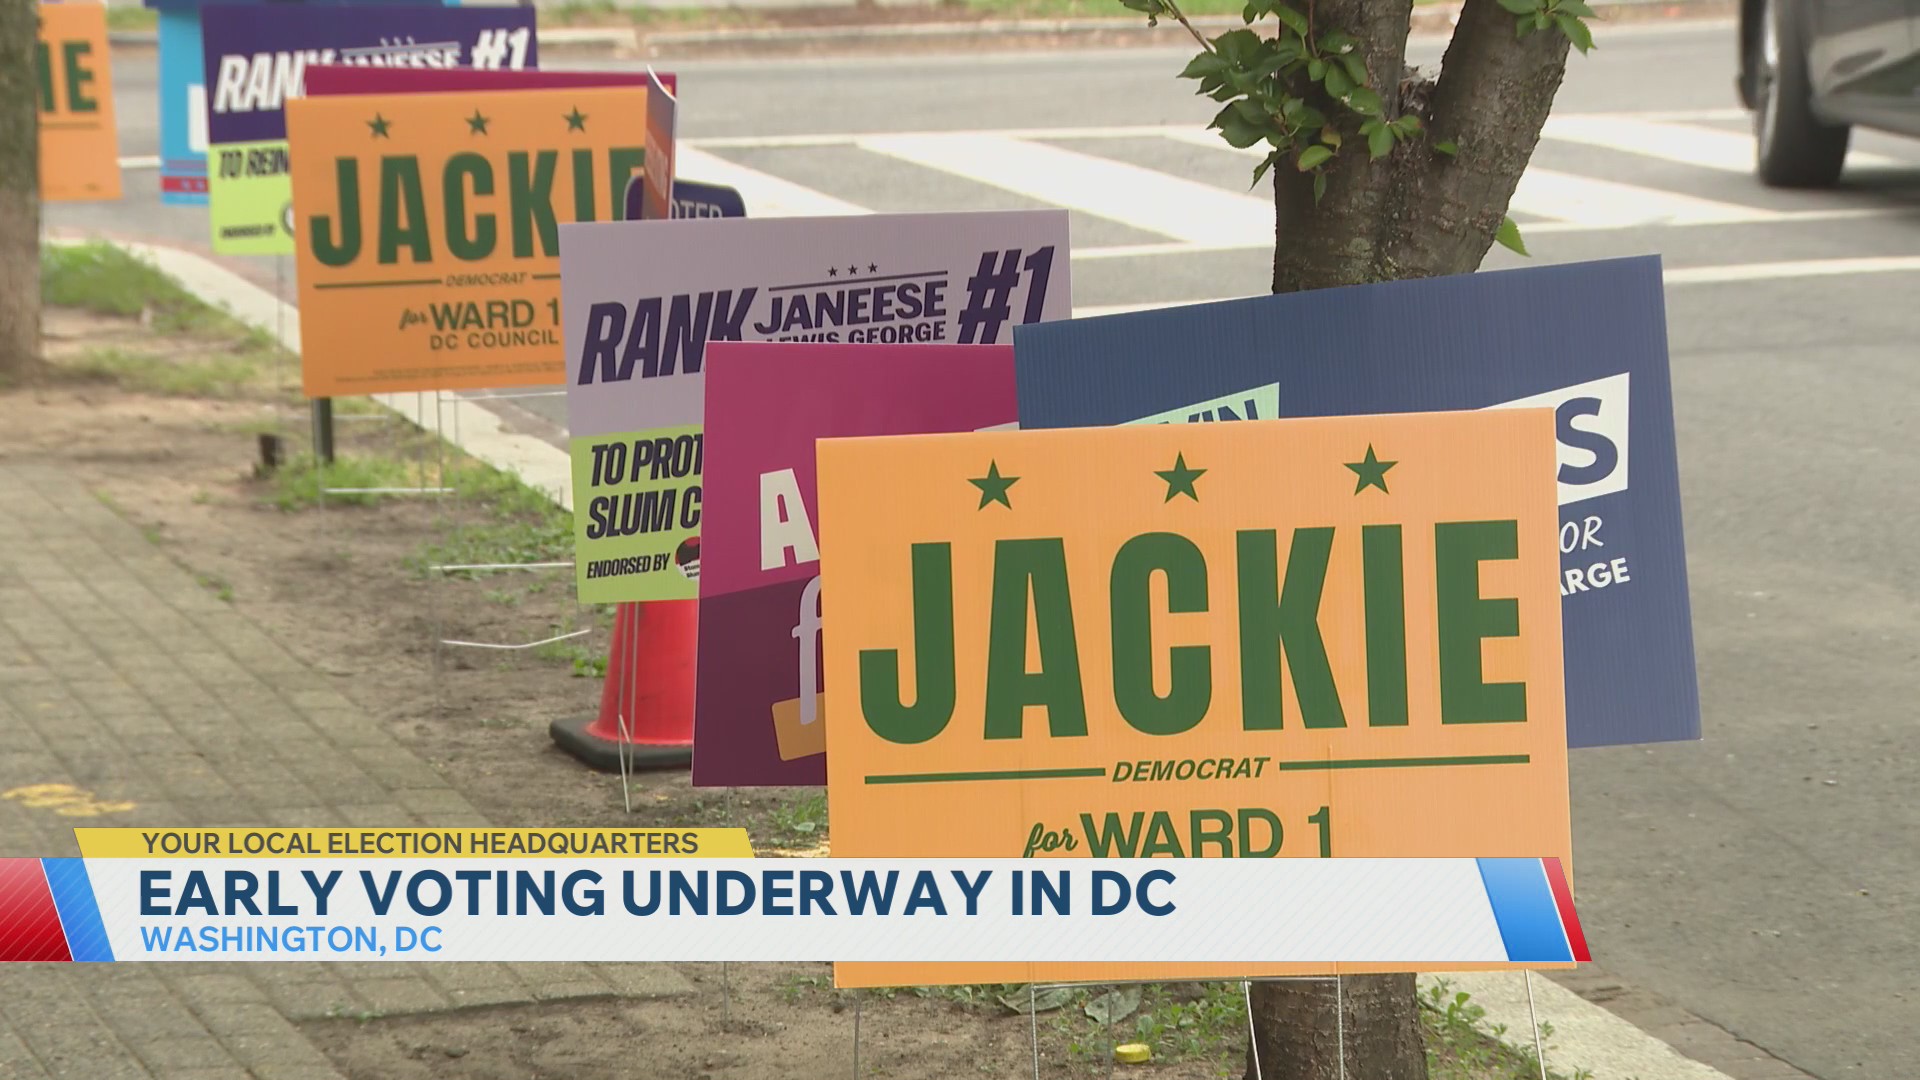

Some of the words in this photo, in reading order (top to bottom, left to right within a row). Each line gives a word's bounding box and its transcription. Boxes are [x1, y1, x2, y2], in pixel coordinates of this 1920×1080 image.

[471, 27, 530, 71] #1
[445, 272, 527, 287] DEMOCRAT
[429, 299, 535, 331] WARD
[547, 298, 560, 327] 1
[577, 287, 759, 385] RANK
[957, 245, 1055, 345] #1
[753, 279, 948, 335] JANEESE
[430, 334, 459, 350] DC
[467, 329, 560, 349] COUNCIL
[847, 320, 947, 343] GEORGE
[591, 441, 628, 487] TO
[586, 489, 677, 540] SLUM
[1559, 515, 1604, 554] OR
[586, 554, 652, 579] ENDORSED
[653, 552, 671, 572] BY
[1561, 557, 1631, 596] RGE
[858, 519, 1529, 745] JACKIE
[1112, 757, 1271, 782] DEMOCRAT
[1023, 822, 1078, 858] for
[1079, 807, 1284, 858] WARD
[1308, 806, 1332, 858] 1
